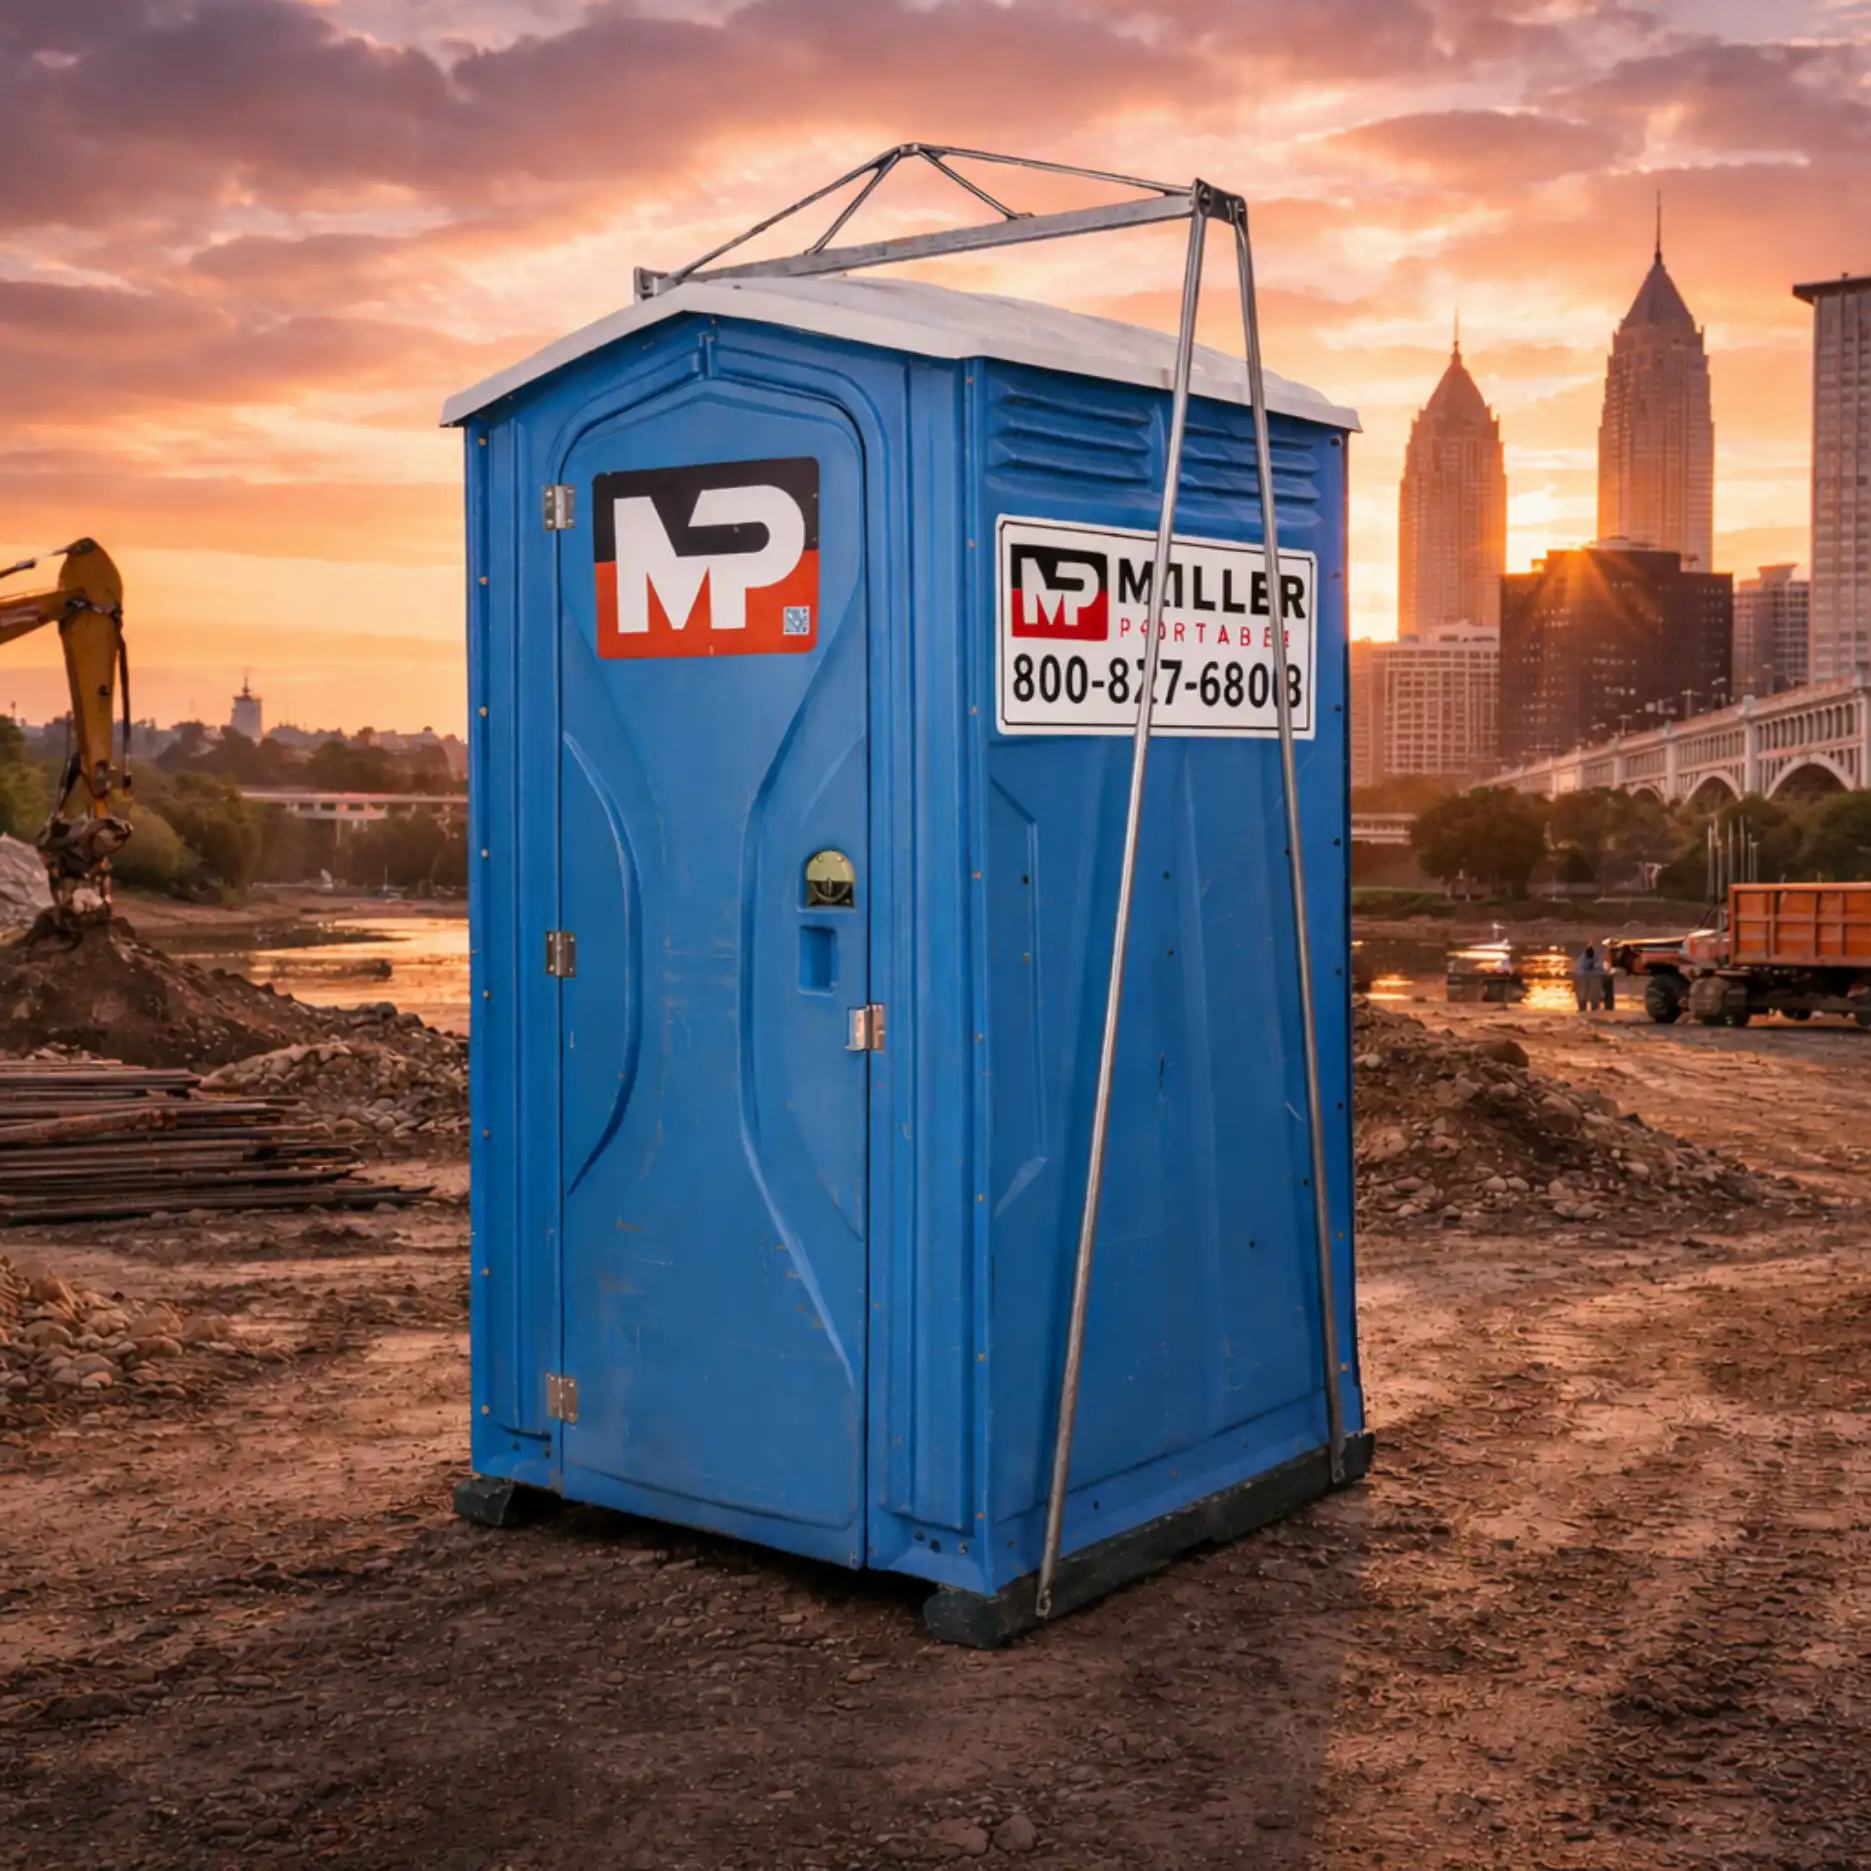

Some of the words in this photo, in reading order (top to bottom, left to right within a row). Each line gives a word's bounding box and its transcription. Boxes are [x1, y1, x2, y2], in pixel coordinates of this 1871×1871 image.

[614, 485, 806, 634] MP
[1021, 556, 1100, 626] MP
[1118, 558, 1306, 619] MILLER
